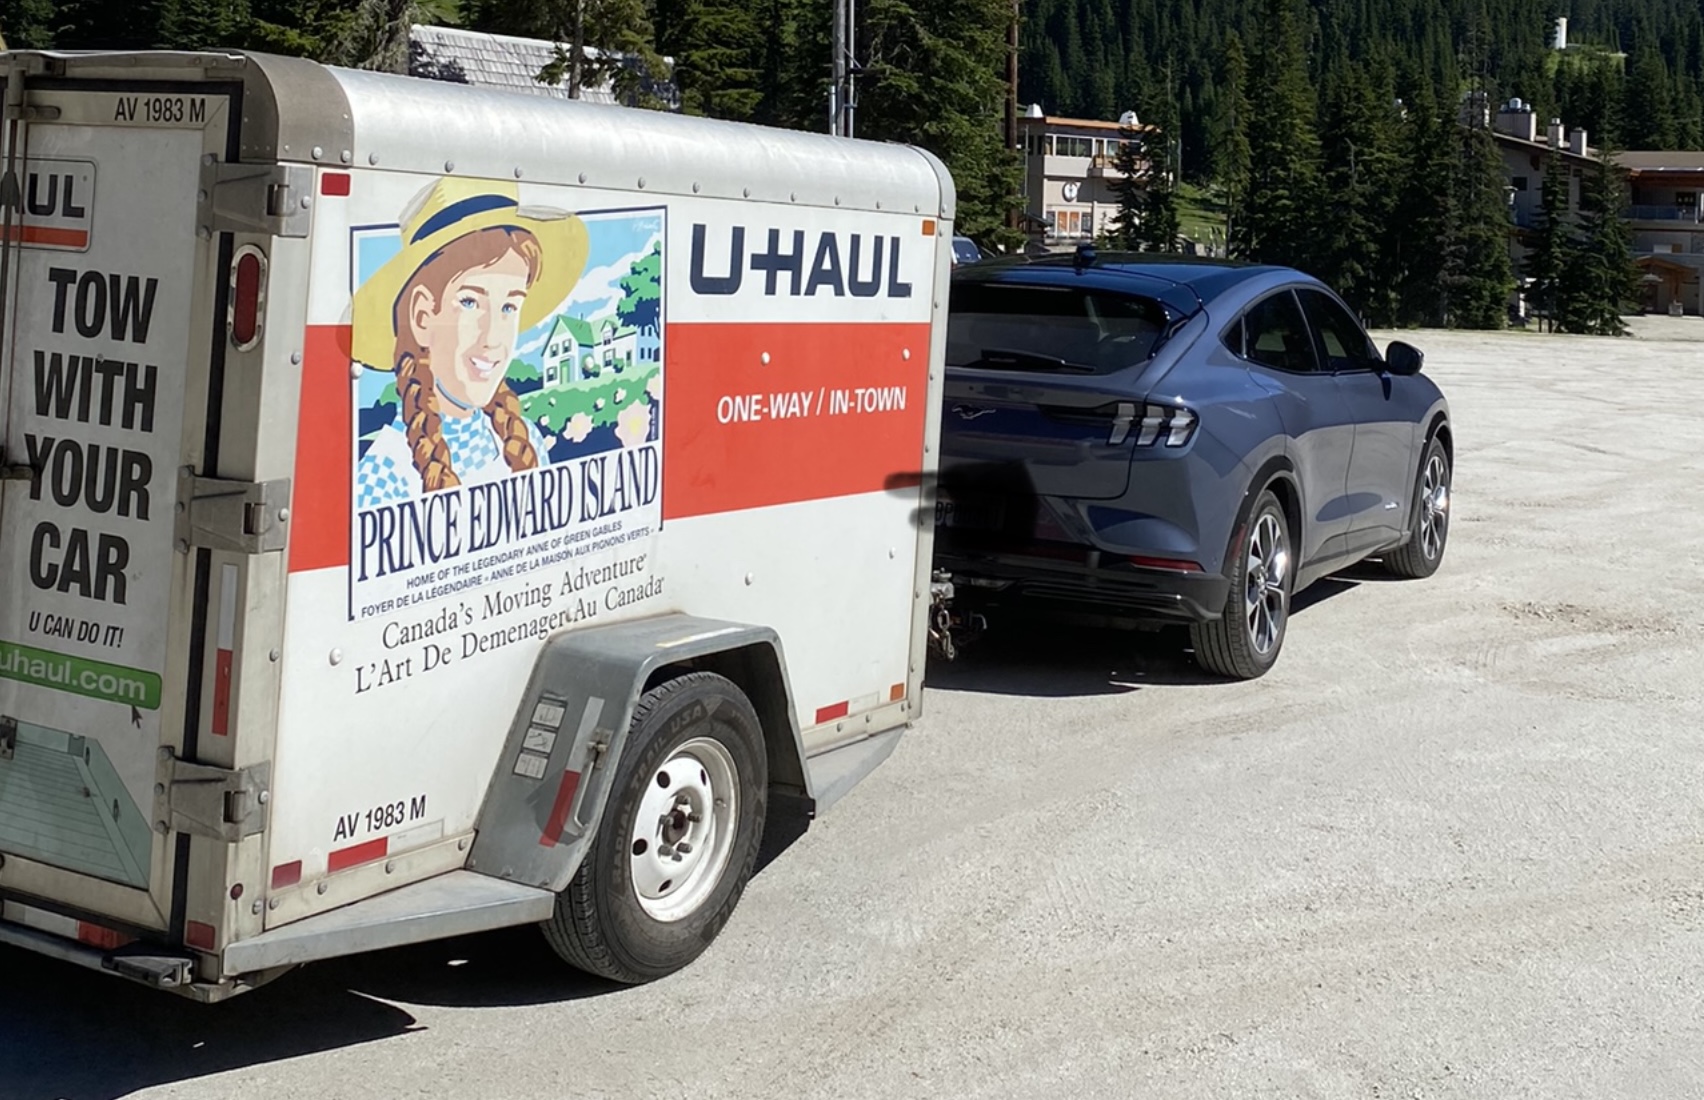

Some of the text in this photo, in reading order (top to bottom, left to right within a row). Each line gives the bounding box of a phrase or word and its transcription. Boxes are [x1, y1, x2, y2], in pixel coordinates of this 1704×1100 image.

[114, 98, 206, 123] AV 1983 M
[689, 223, 912, 298] U-HAUL
[48, 266, 159, 344] TOW
[33, 350, 158, 433] WITH
[716, 391, 814, 425] ONE-WAY
[829, 386, 907, 415] IN-TOWN
[24, 432, 153, 521] YOUR
[357, 445, 659, 582] PRINCE EDWARD ISLAND
[29, 520, 130, 605] CAR
[361, 599, 394, 618] FOYER
[396, 595, 410, 609] DE
[411, 591, 424, 604] LA
[490, 566, 514, 581] ANNE
[516, 561, 528, 574] DE
[529, 557, 540, 570] LA
[541, 550, 573, 565] MAISON
[574, 545, 592, 557] AUX
[592, 534, 626, 553] PIGNONS
[627, 526, 650, 542] VERTS
[406, 521, 622, 590] HOME OF THE LEGENDARY ANNE OF GREEN GABLES
[29, 611, 124, 648] U CAN DO IT!
[355, 575, 664, 694] L'Art De Demenager Au Canada
[382, 554, 647, 650] Canada's Moving Adventure
[0, 649, 146, 701] uhaul.com
[670, 706, 706, 734] USA
[333, 794, 426, 842] AV 1983 M
